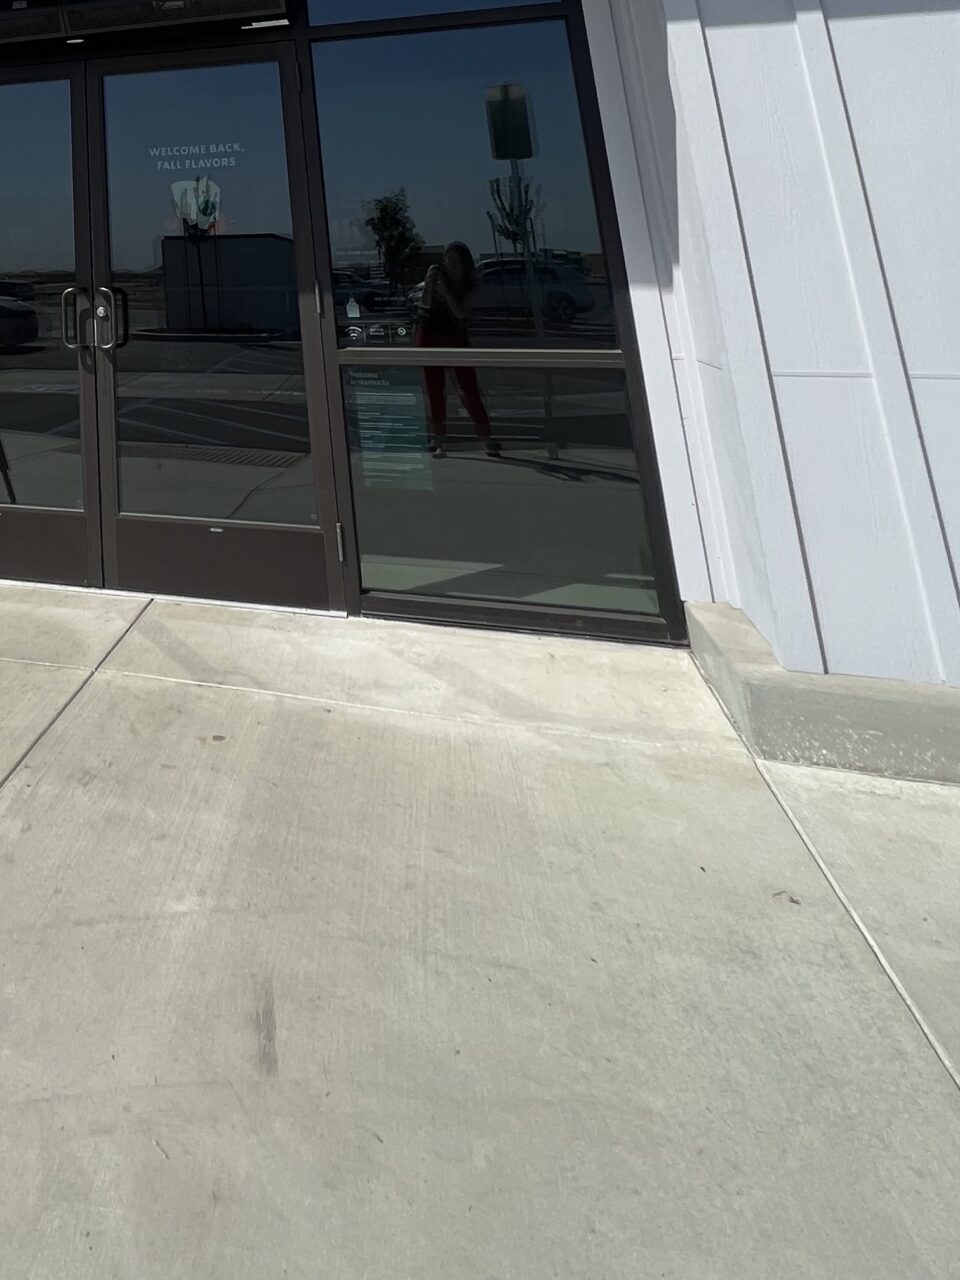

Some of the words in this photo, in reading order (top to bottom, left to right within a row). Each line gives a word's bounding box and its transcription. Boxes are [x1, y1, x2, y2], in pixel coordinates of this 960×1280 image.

[149, 145, 207, 157] WELCOME
[157, 161, 182, 170] FALL
[185, 157, 236, 169] FLAVORS
